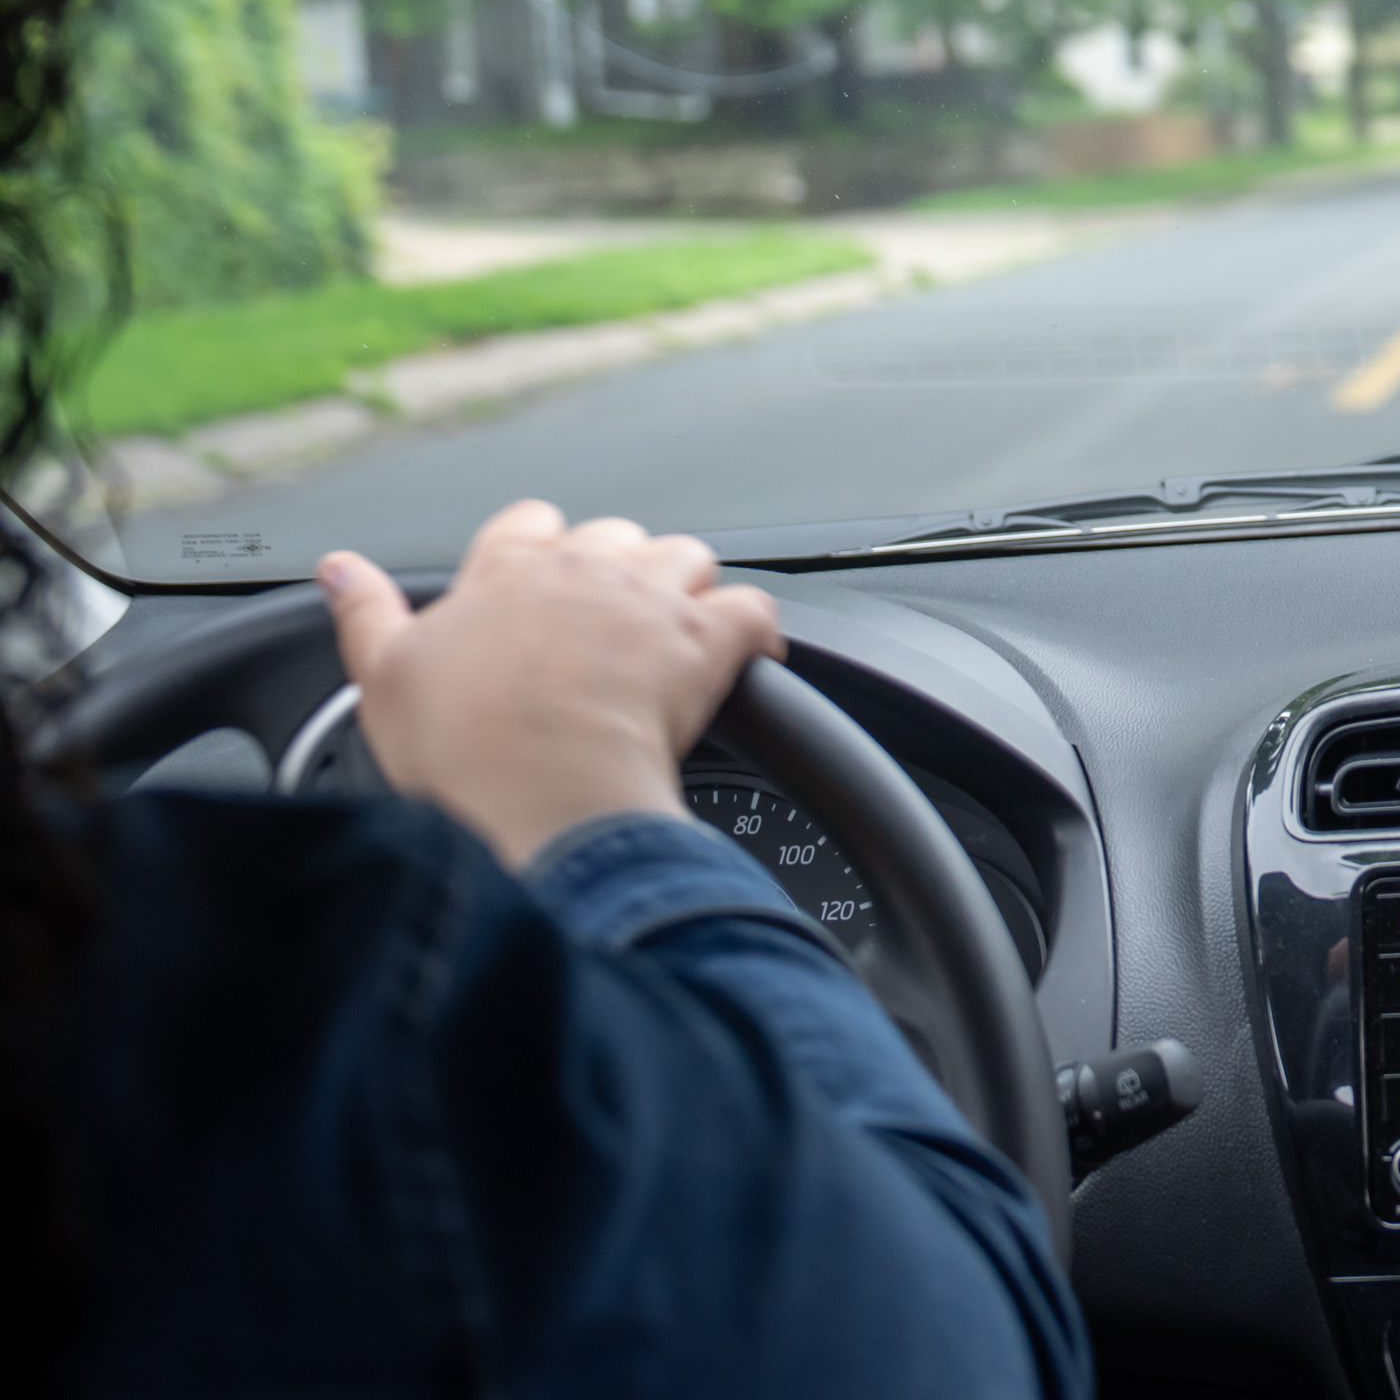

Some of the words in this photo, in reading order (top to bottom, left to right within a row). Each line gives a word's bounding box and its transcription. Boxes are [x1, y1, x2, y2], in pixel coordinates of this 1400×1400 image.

[733, 815, 762, 835] 80
[778, 845, 816, 865] 100
[820, 901, 855, 921] 120
